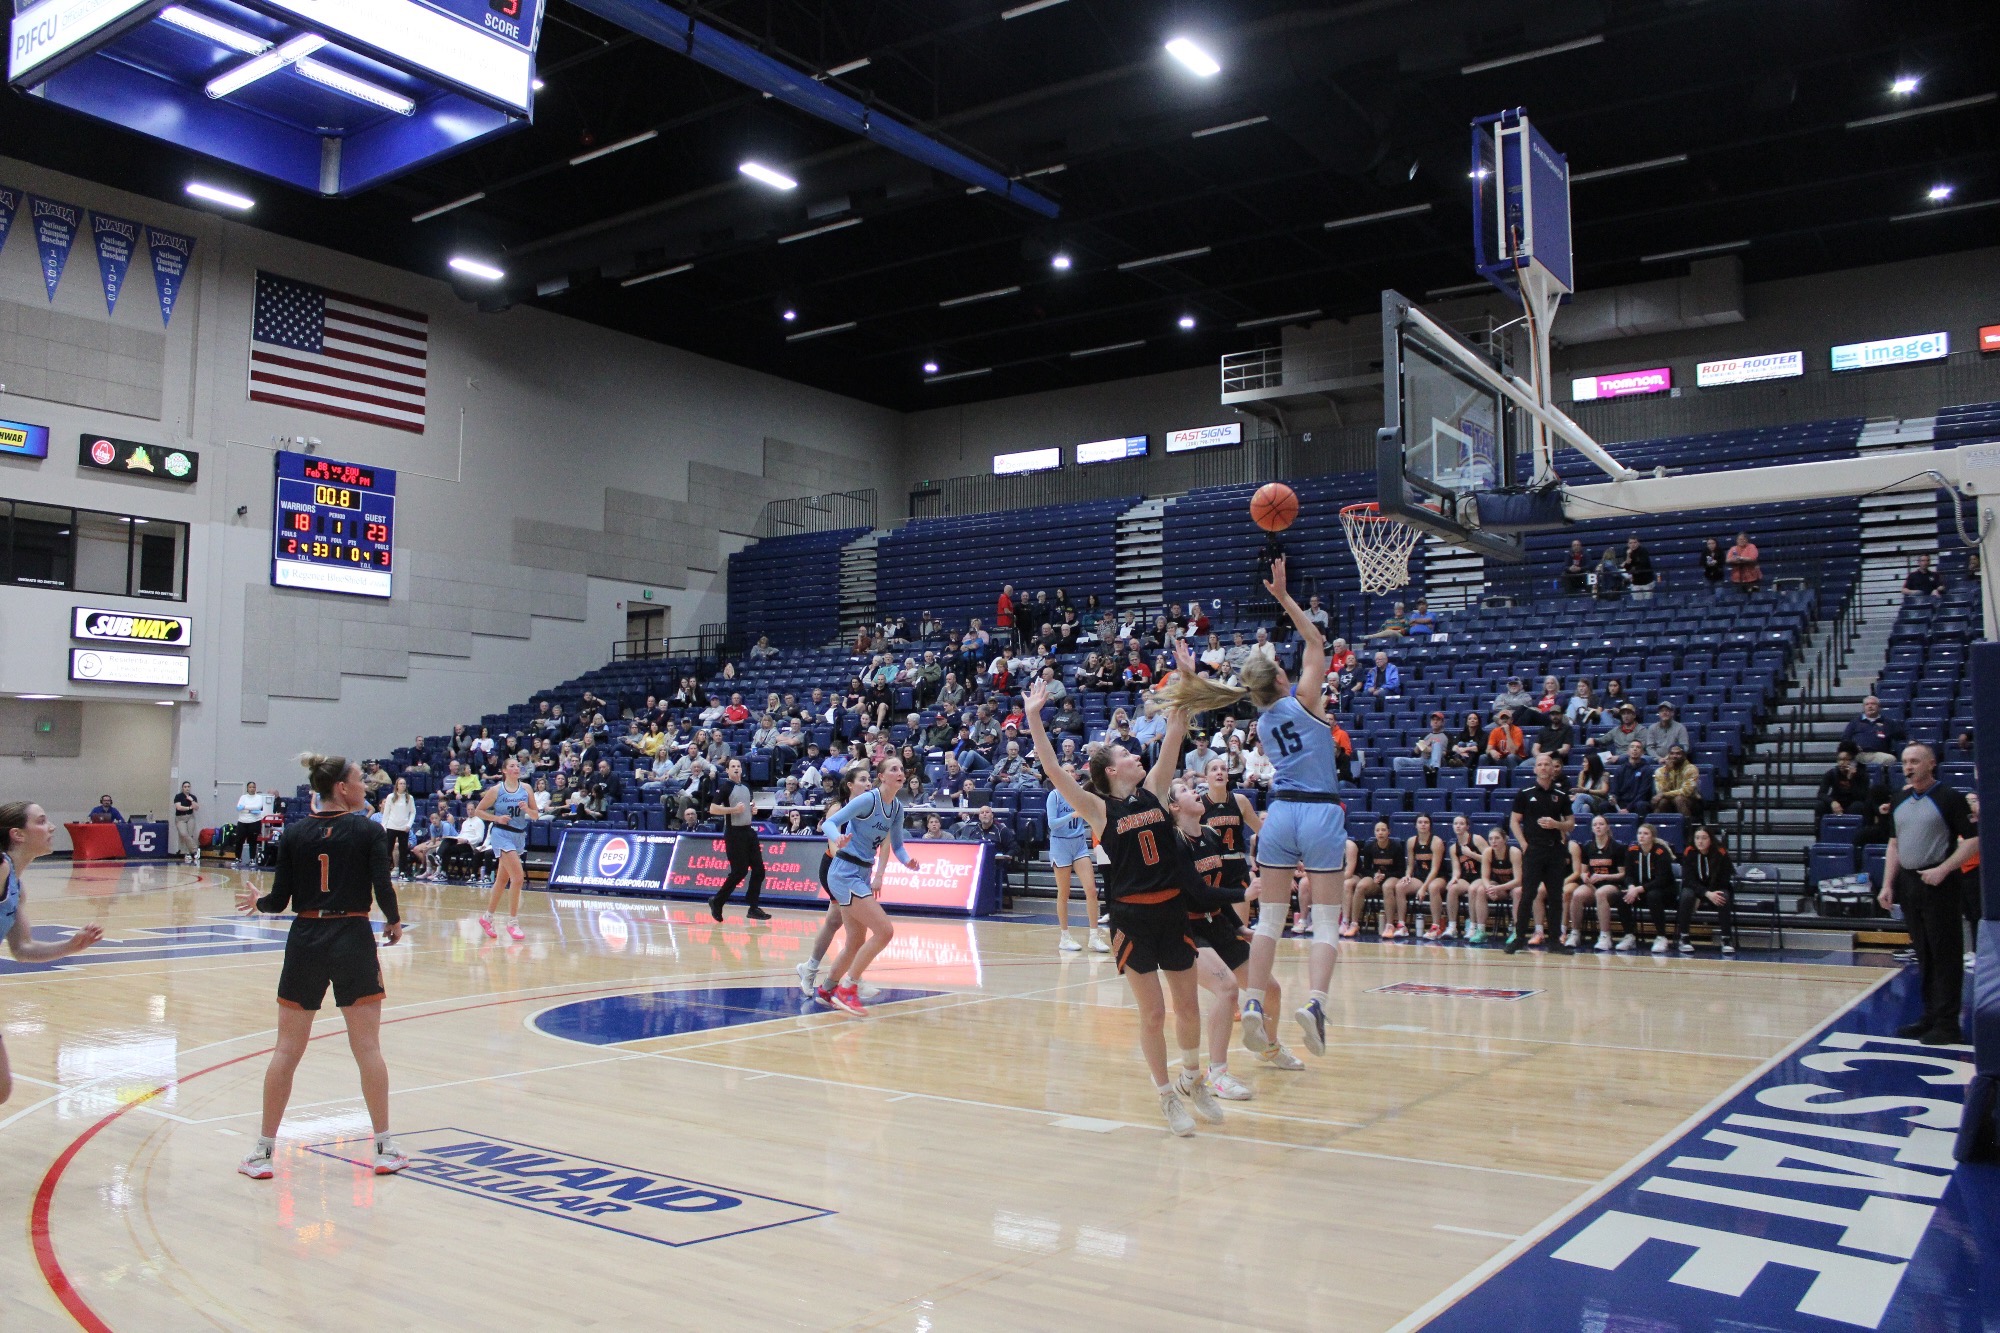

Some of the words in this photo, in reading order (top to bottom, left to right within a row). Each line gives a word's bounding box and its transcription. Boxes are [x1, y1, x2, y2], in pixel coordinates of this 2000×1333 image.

[484, 13, 520, 40] SCORE
[35, 201, 76, 227] NAIA
[42, 220, 68, 233] National
[95, 216, 134, 242] NAIA
[40, 227, 70, 241] Champion
[42, 235, 67, 247] Baseball
[100, 243, 129, 255] Champion
[103, 236, 127, 248] National
[152, 232, 188, 256] NAIA
[102, 251, 126, 262] Baseball
[158, 250, 181, 262] National
[156, 258, 183, 269] Champion
[157, 265, 180, 276] Baseball
[1865, 336, 1940, 359] image!
[1702, 354, 1797, 374] ROTO-ROOTER
[1175, 427, 1232, 442] FASTSIGNS
[306, 468, 321, 478] Feb
[324, 470, 329, 479] 3
[360, 476, 370, 486] PM
[332, 466, 342, 474] vs
[281, 501, 316, 513] WARRIORS
[294, 513, 310, 531] 18
[329, 512, 346, 520] PERIOD
[365, 514, 386, 524] GUEST
[281, 530, 297, 538] FOULS
[367, 524, 387, 542] 23
[287, 540, 297, 552] 2
[312, 543, 329, 557] 33
[351, 547, 360, 562] 0
[381, 552, 389, 565] 3
[1588, 573, 1598, 585] B
[1212, 599, 1221, 609] C
[90, 616, 179, 639] SUBWAY
[1271, 721, 1303, 757] 15
[1117, 808, 1165, 834] JAMESTOWN
[132, 825, 157, 852] LC
[768, 842, 787, 854] at
[1138, 829, 1160, 866] 0
[602, 853, 626, 861] PEPSI
[318, 853, 330, 892] 1
[934, 858, 973, 878] River
[555, 875, 583, 884] ADMIRAL
[583, 877, 615, 886] BEVERAGE
[615, 879, 661, 888] CORPORATION
[667, 872, 691, 886] For
[765, 876, 818, 892] Tickets
[909, 875, 920, 889] &
[921, 878, 958, 888] LODGE
[419, 1141, 743, 1213] INLAND
[408, 1158, 632, 1217] CELLULAR
[1550, 1084, 1963, 1329] STATE
